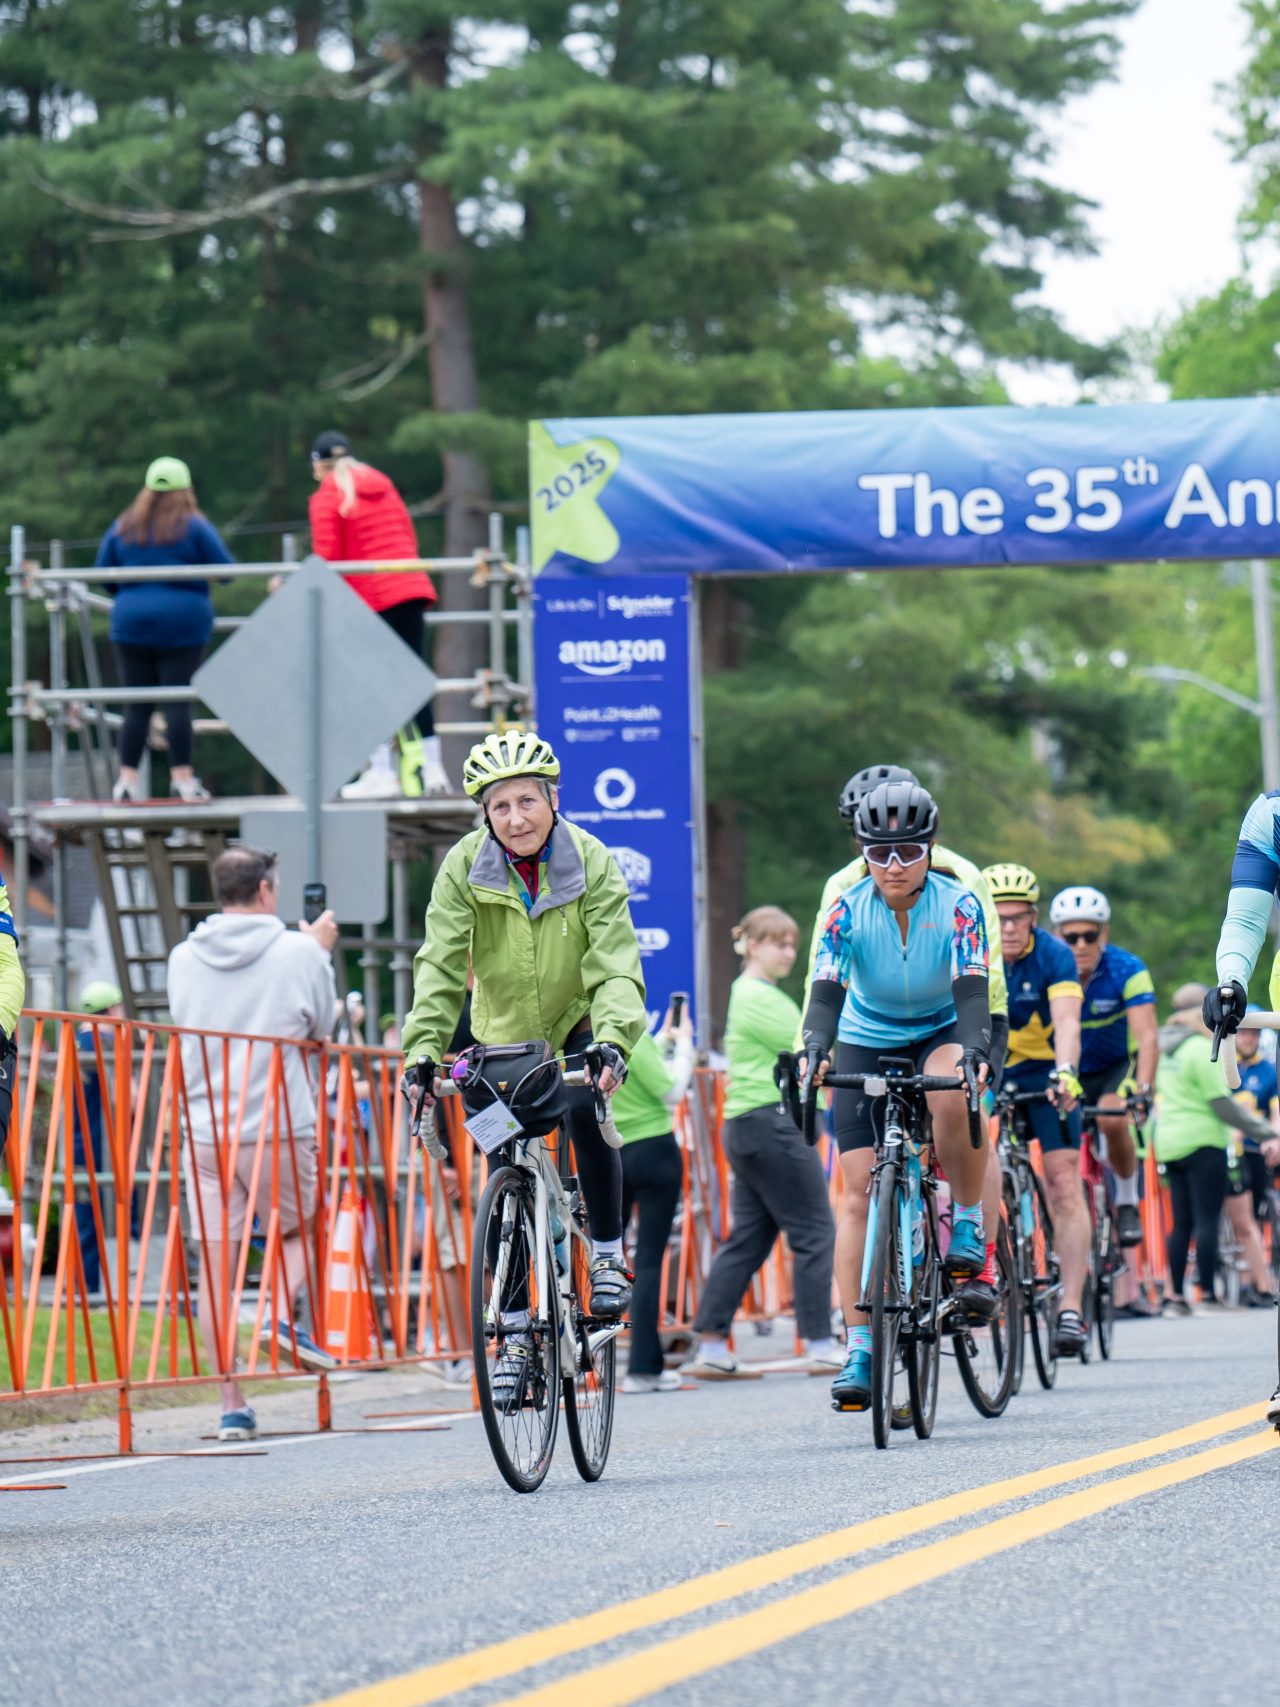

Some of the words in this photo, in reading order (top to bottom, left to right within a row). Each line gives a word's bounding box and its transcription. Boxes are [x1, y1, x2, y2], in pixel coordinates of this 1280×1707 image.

[536, 449, 607, 511] 2025
[857, 471, 1004, 538] The
[558, 639, 667, 664] amazon
